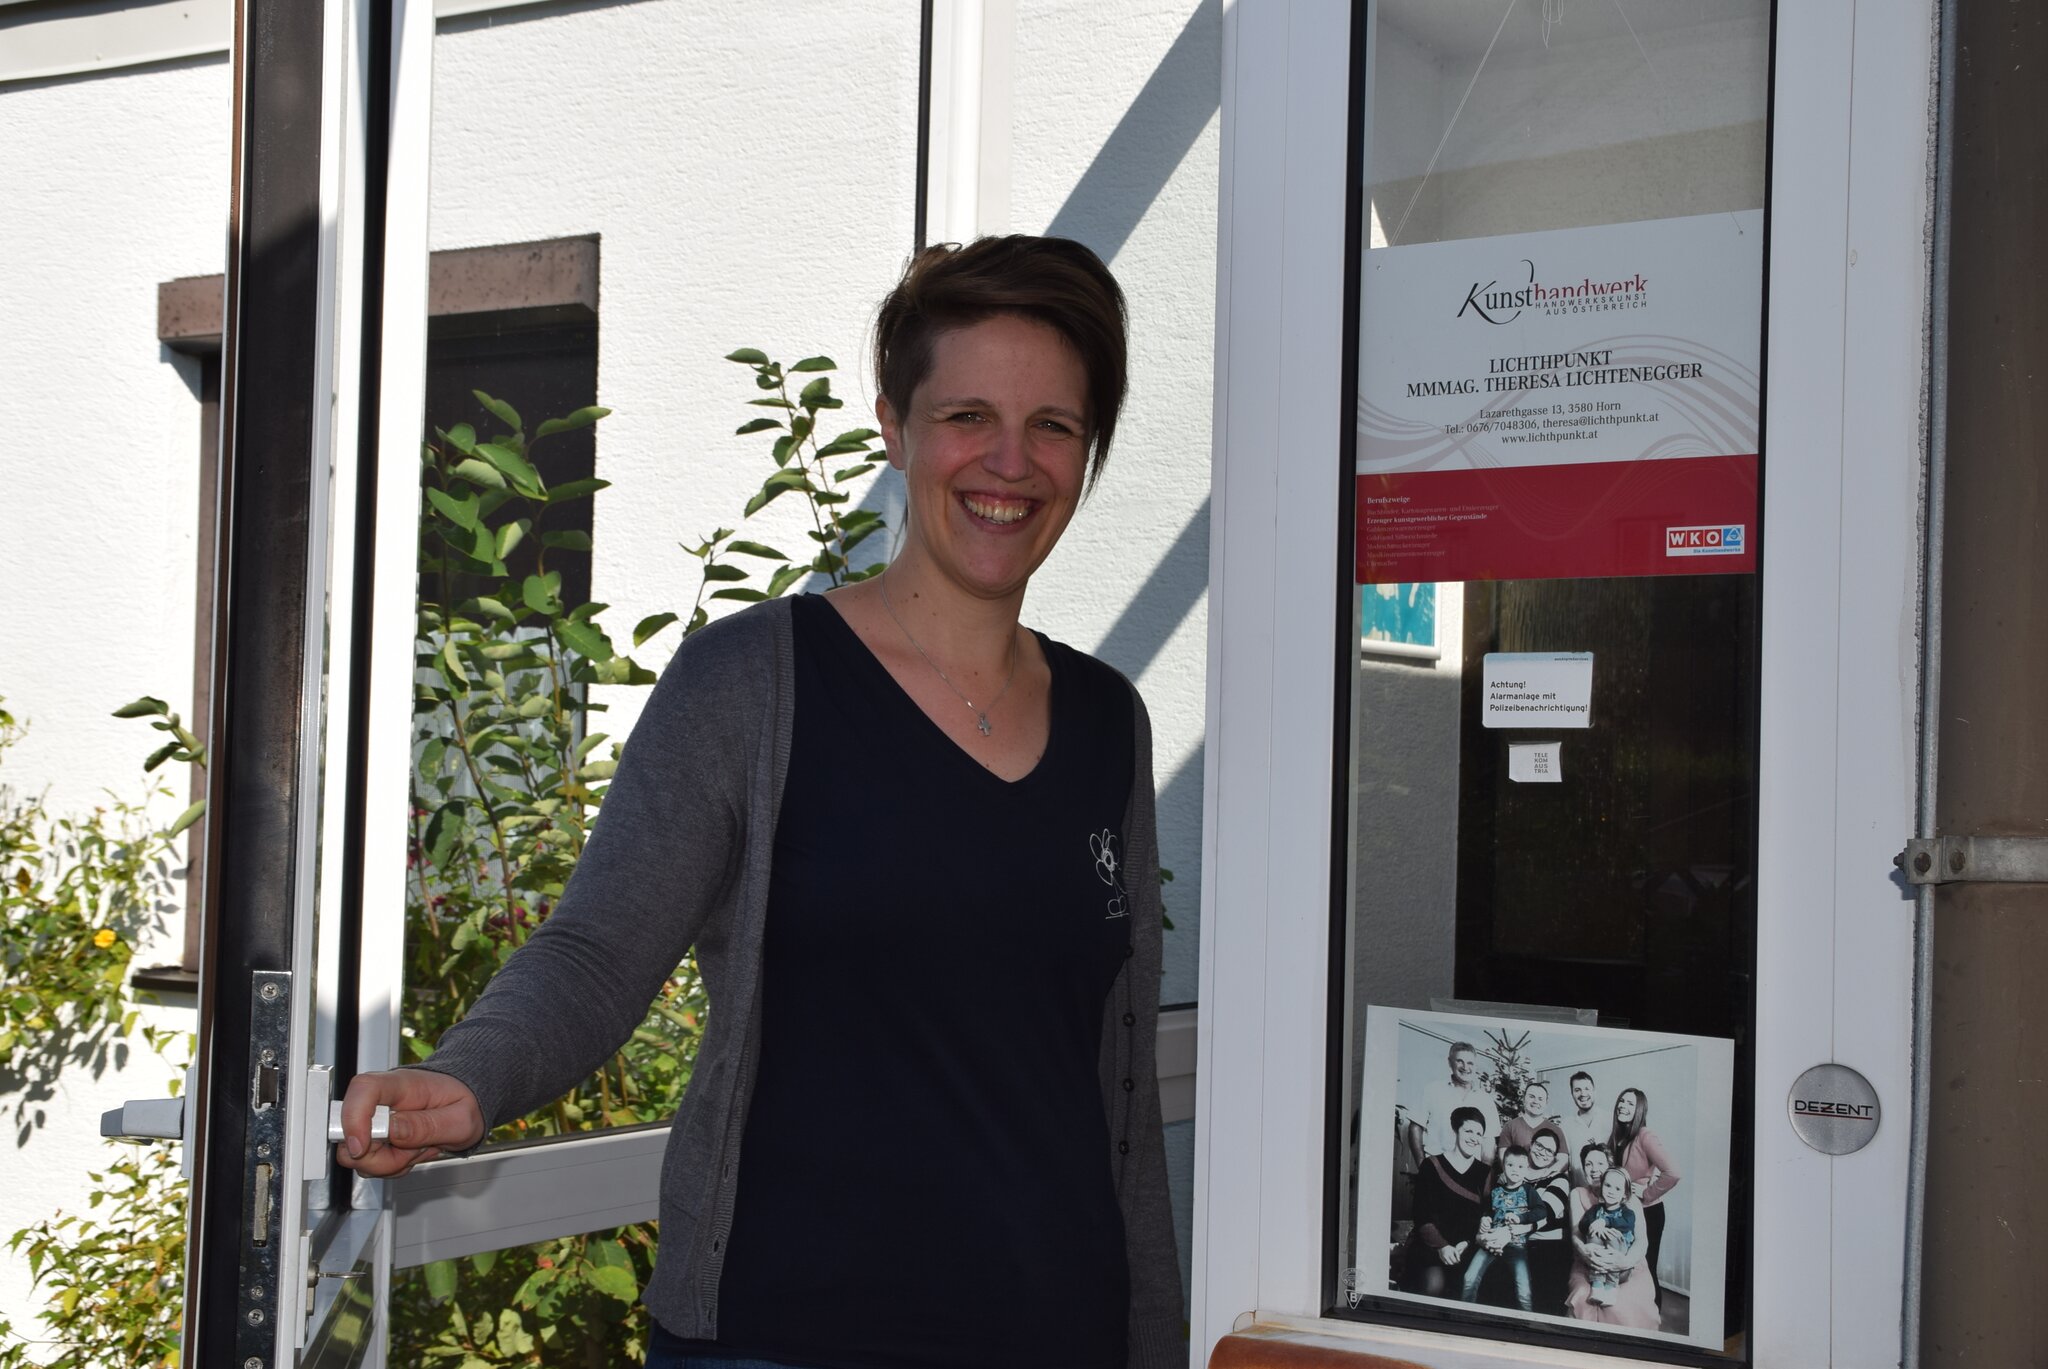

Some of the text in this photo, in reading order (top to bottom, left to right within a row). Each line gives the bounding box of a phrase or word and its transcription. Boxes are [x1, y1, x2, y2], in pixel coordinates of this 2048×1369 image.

[1535, 293, 1647, 309] HANDWERKSKUNST
[1546, 302, 1647, 316] AUS ÖSTERREICH
[1489, 351, 1613, 374] LICHTHPUNKT
[1406, 363, 1703, 398] MMMAG. THERESA LICHTENEGGER
[1479, 402, 1621, 419] Lazarethgasse 13, 3580 Horn
[1445, 413, 1659, 434] Tel.: 0676/7048306, theresa@lichthpunkt.at
[1501, 430, 1598, 444] www.lichthpunkt.at
[1670, 531, 1719, 545] WKO
[1490, 681, 1526, 689] Achtung!
[1489, 692, 1556, 701] Alarmanlage mit
[1489, 704, 1588, 713] Polizeibenachrichtigung!
[1794, 1100, 1874, 1116] DEZENT
